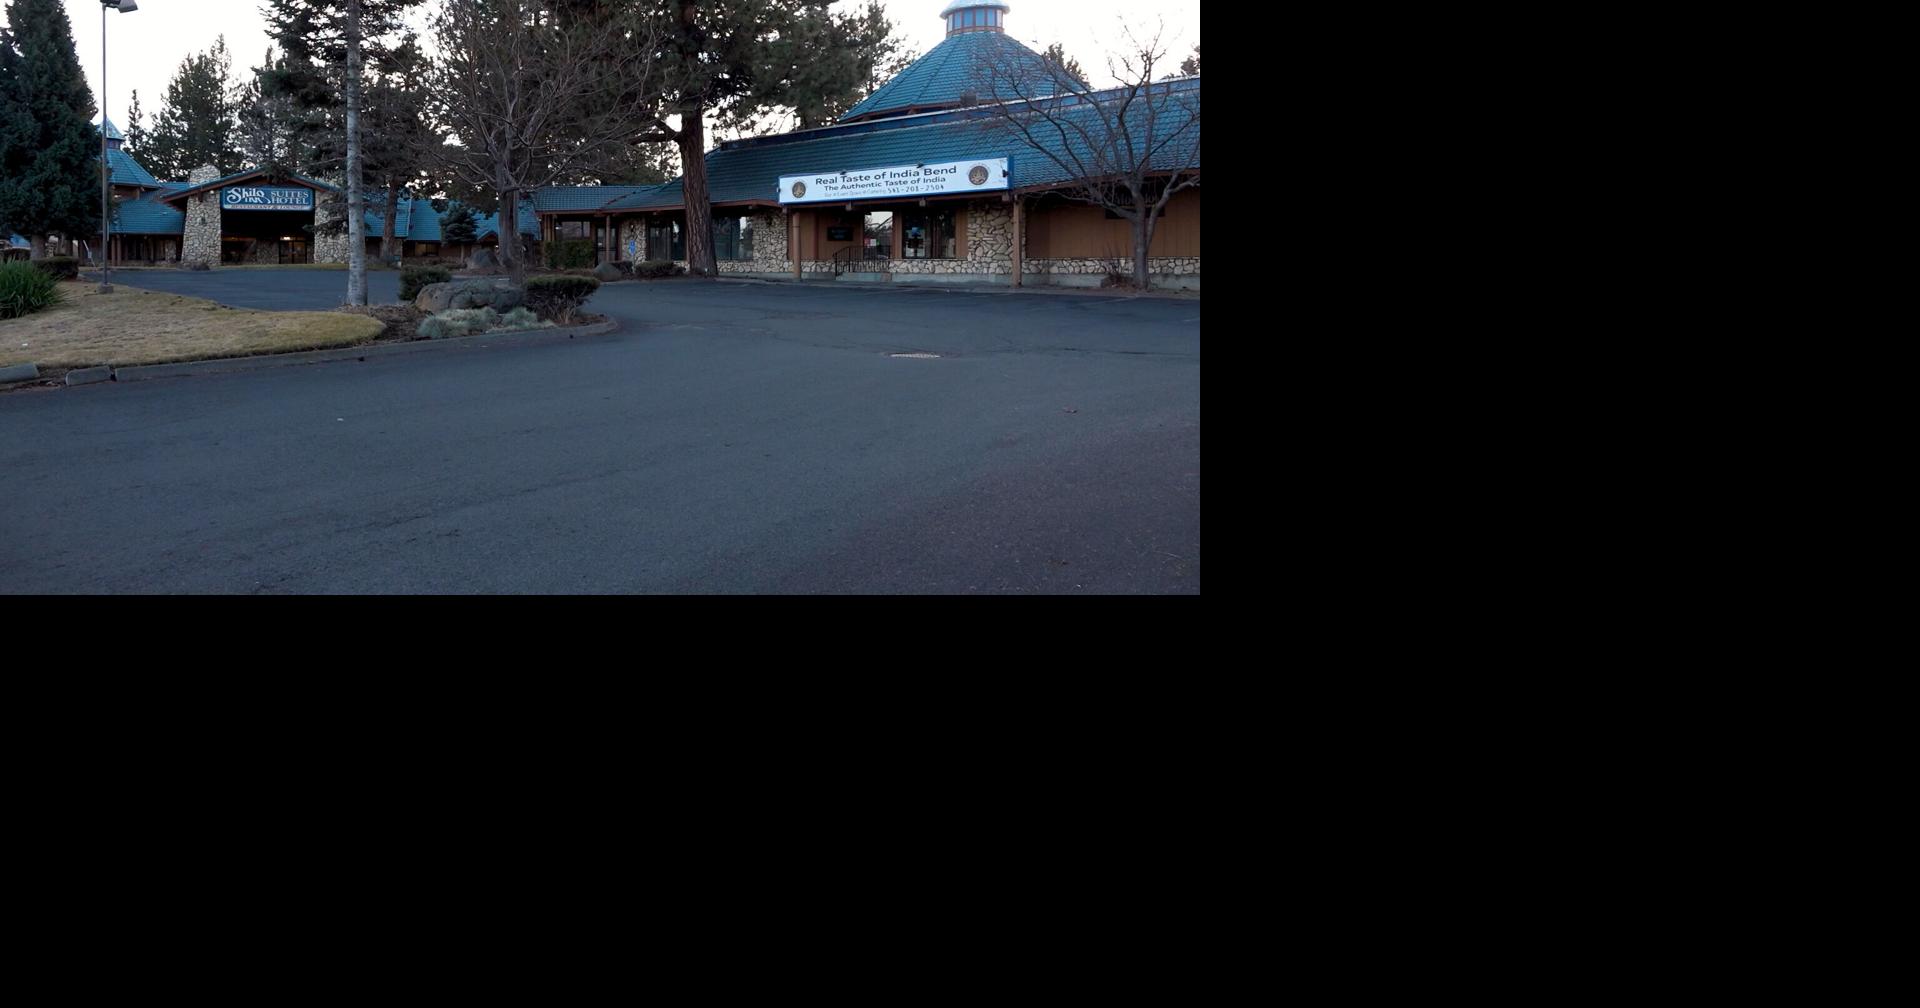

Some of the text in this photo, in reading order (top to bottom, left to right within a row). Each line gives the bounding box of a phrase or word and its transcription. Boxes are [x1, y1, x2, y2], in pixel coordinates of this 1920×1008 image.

[815, 165, 957, 185] Real Taste of India Bend
[840, 181, 882, 191] Authentic
[885, 179, 908, 187] Taste
[226, 187, 265, 204] Shilo
[271, 190, 309, 198] SUITES
[271, 197, 309, 205] HOTEL
